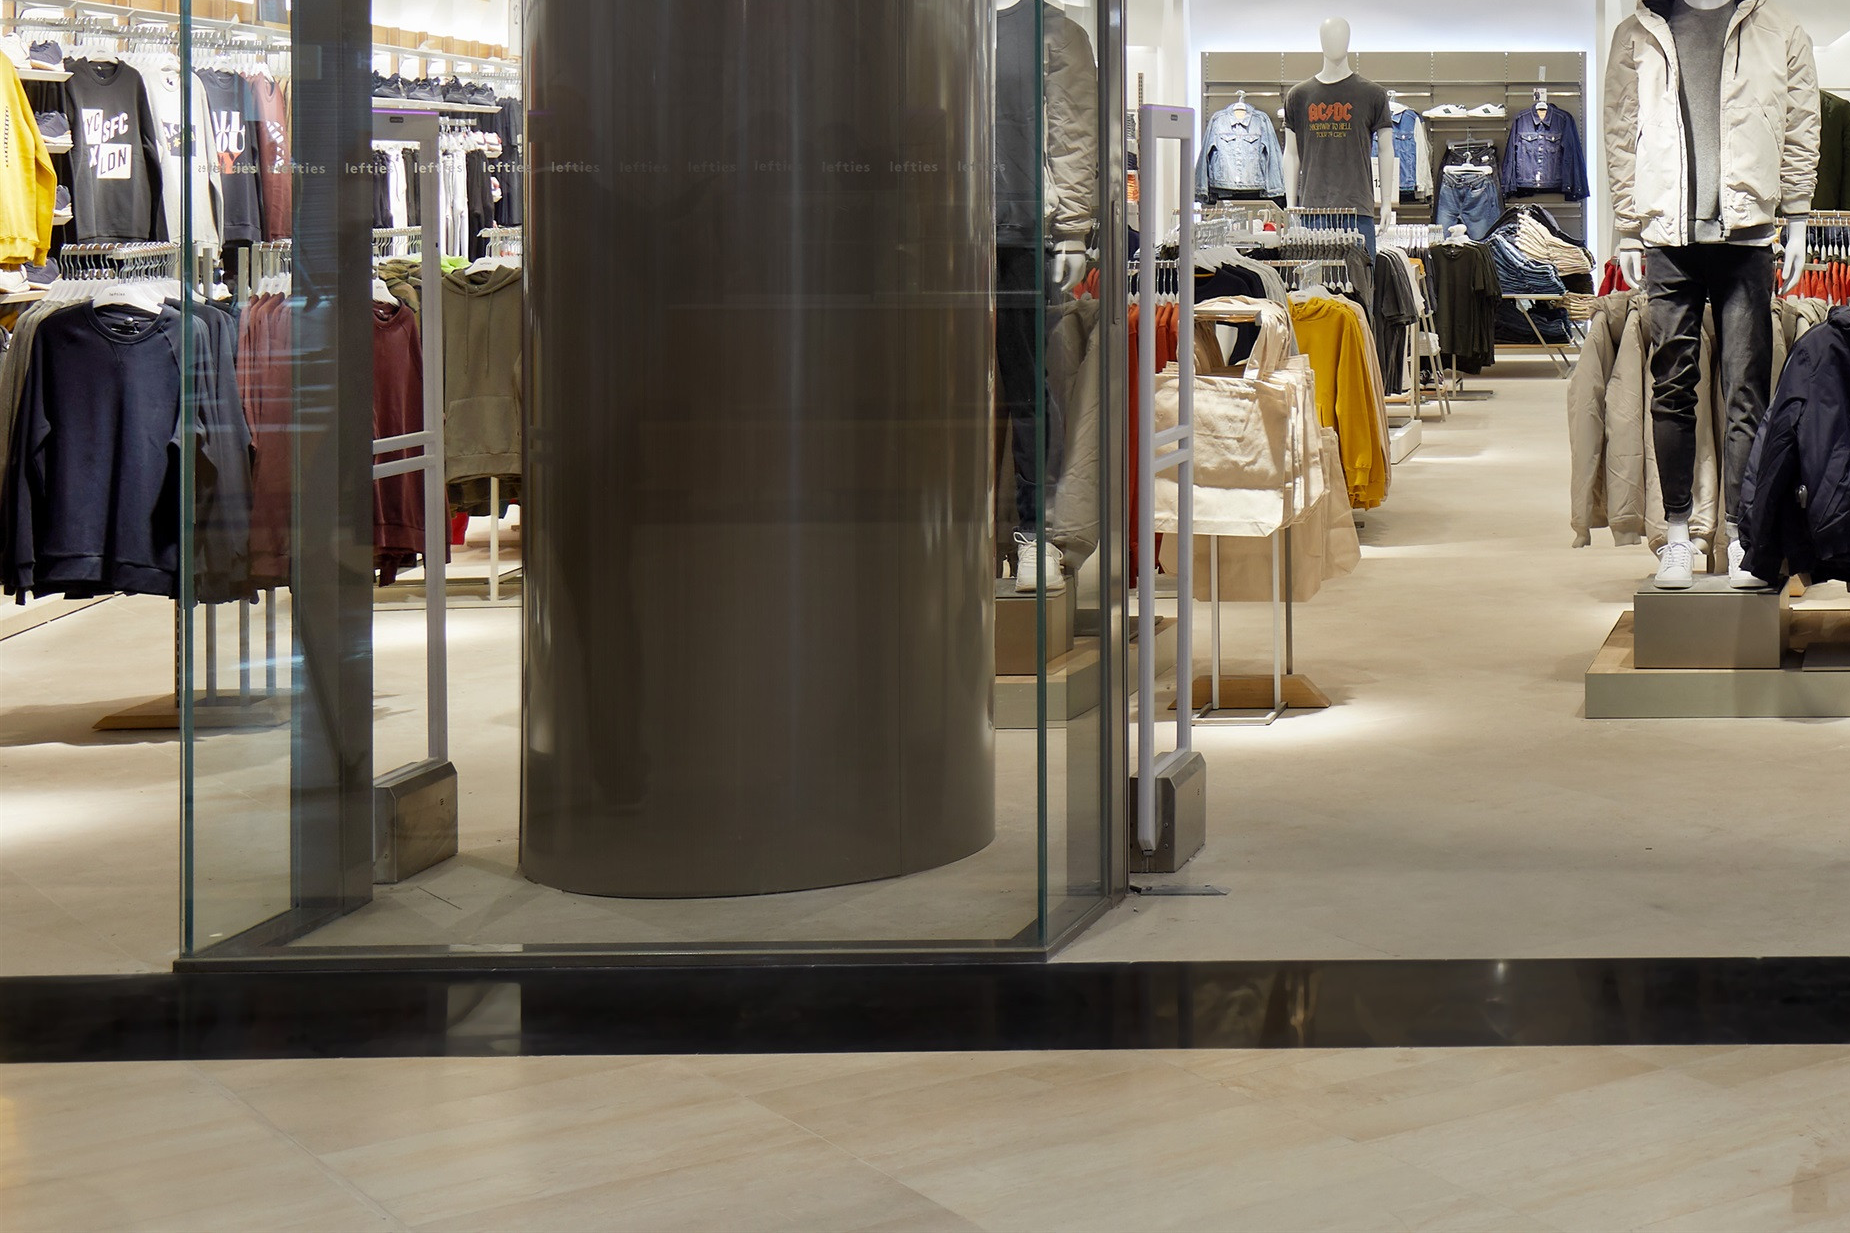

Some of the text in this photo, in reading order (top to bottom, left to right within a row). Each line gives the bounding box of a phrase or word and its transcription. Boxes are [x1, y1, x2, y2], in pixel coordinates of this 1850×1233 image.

[89, 145, 127, 176] X LDN
[414, 162, 463, 174] leftes
[551, 161, 601, 173] lefties
[619, 161, 669, 173] lefties
[688, 161, 737, 173] lefties
[821, 161, 871, 173] lefties
[889, 161, 939, 173] lefties
